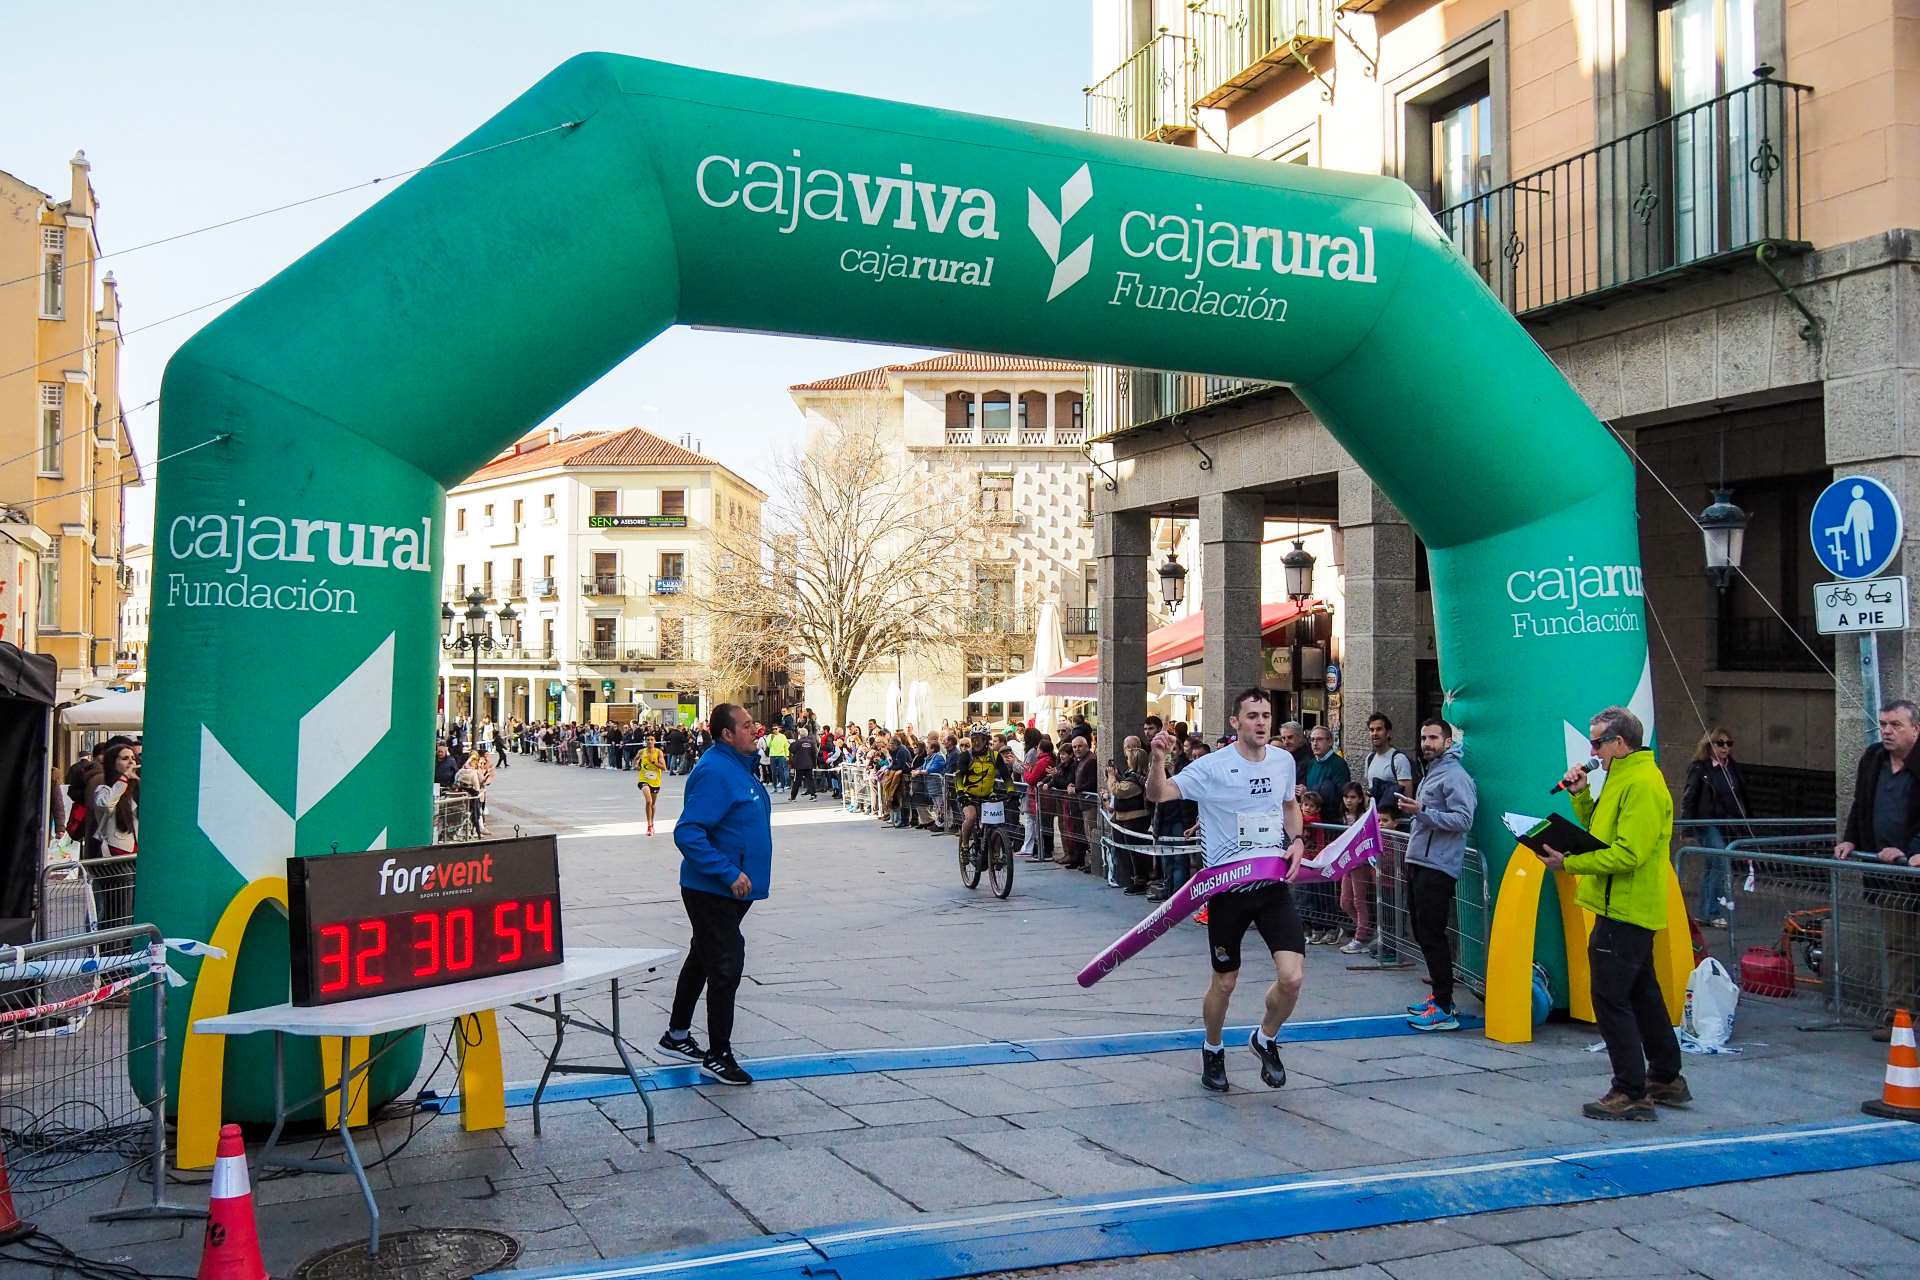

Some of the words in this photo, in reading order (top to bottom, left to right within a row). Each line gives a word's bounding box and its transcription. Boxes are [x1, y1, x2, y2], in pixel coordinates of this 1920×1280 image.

[695, 148, 1000, 241] cajaviva
[1119, 203, 1378, 284] cajarural
[839, 244, 996, 288] cajarural
[1108, 270, 1289, 323] Fundación
[169, 498, 432, 574] cajarural
[590, 516, 612, 527] SEN
[620, 518, 646, 526] ASESORES
[167, 573, 359, 614] Fundación
[1511, 606, 1640, 639] Fundación
[1838, 613, 1849, 627] A
[1858, 610, 1885, 625] PIE
[378, 852, 494, 896] forevent
[320, 918, 388, 993] 32
[413, 906, 474, 977] 30
[495, 900, 553, 963] 54
